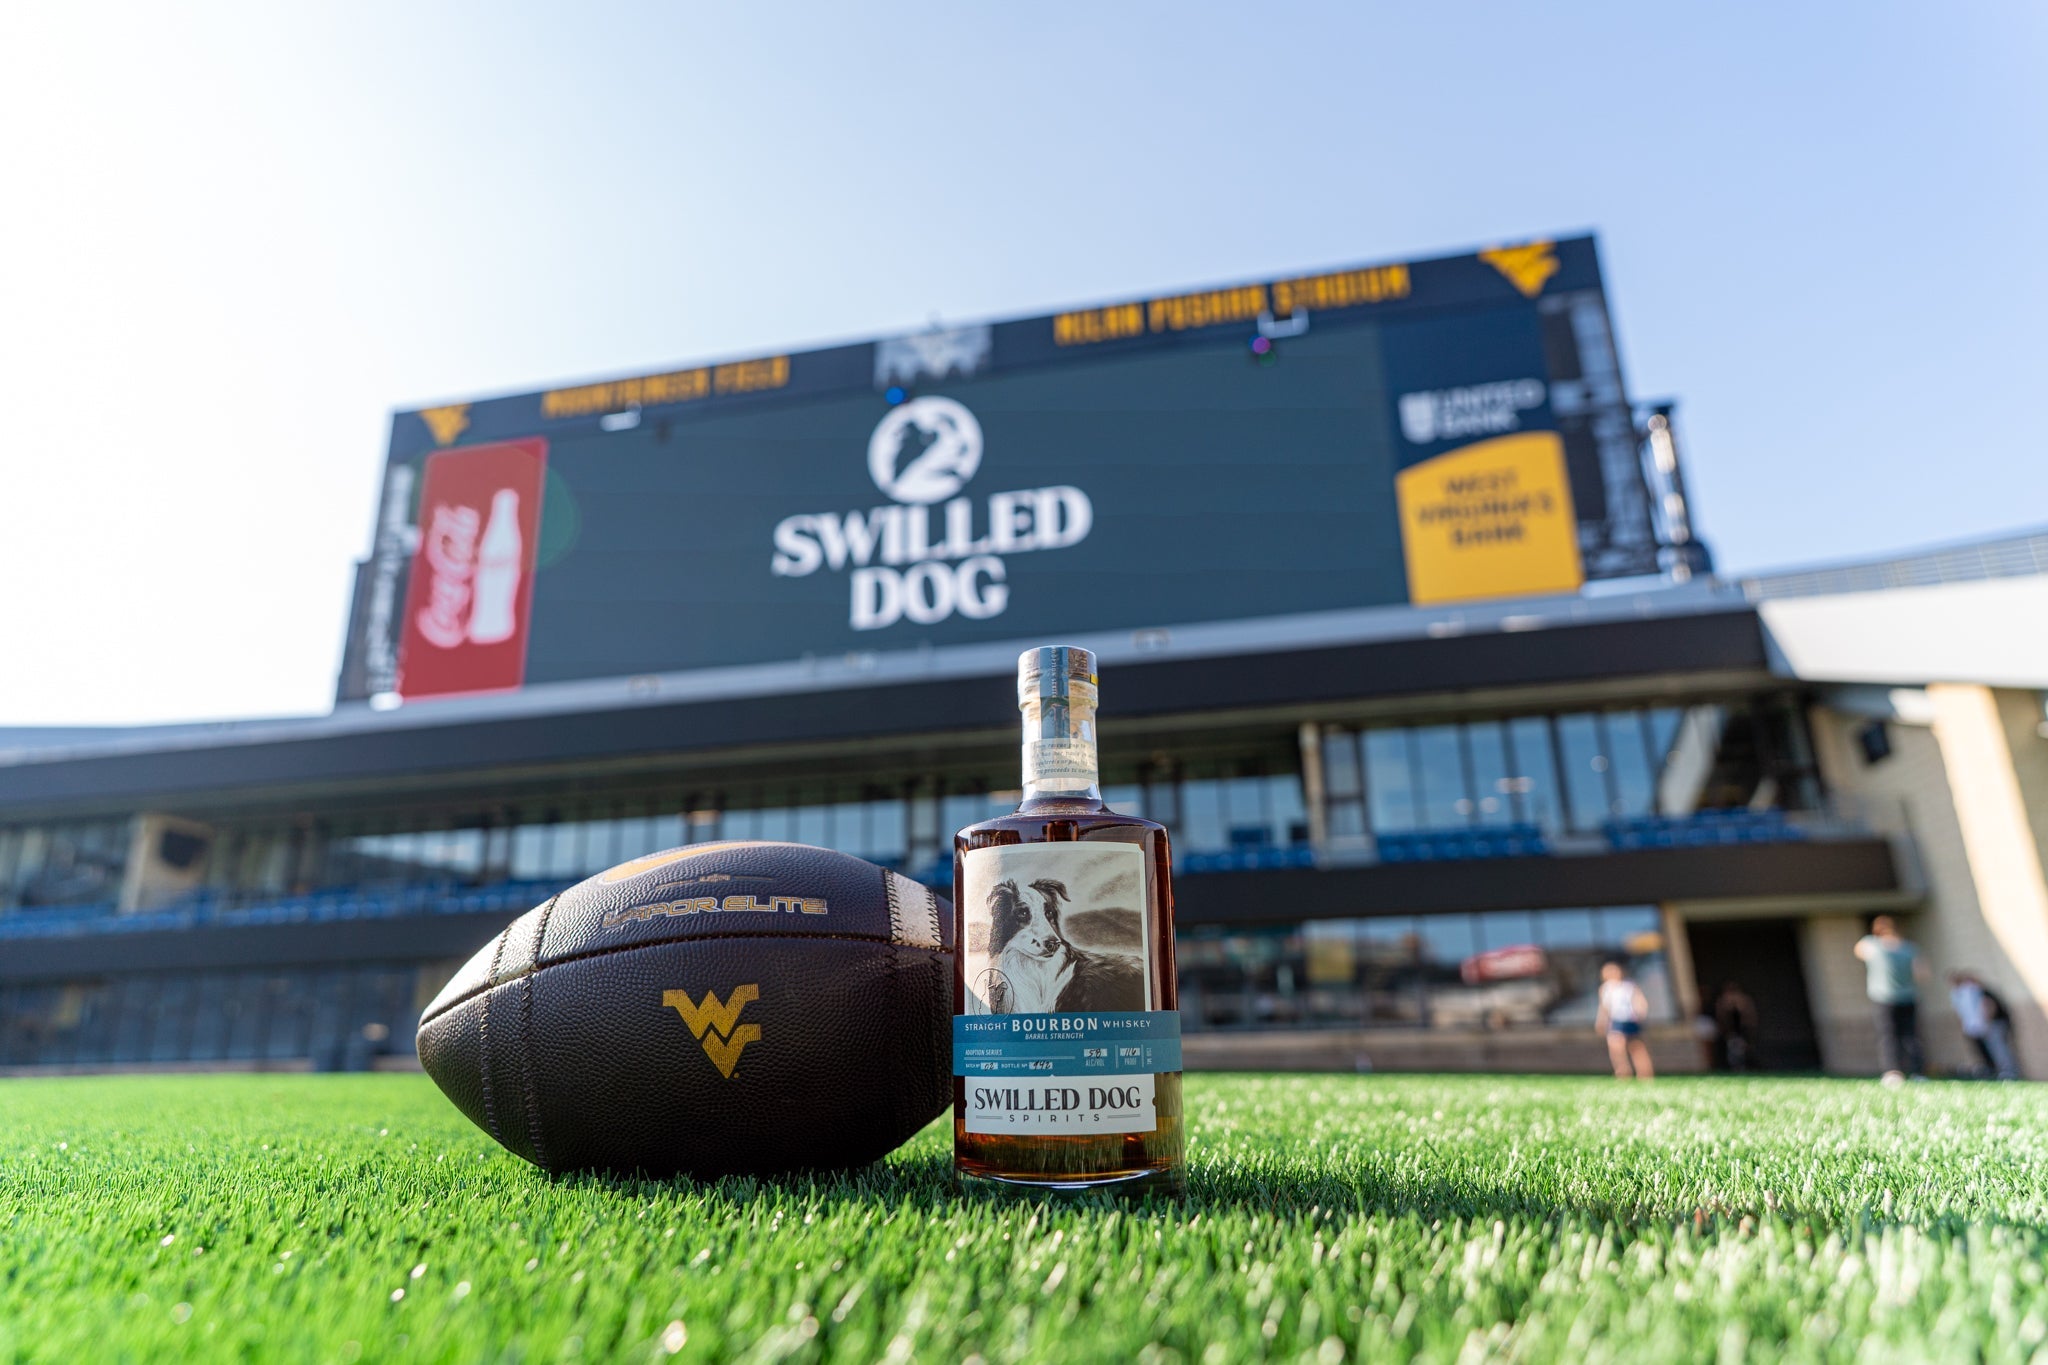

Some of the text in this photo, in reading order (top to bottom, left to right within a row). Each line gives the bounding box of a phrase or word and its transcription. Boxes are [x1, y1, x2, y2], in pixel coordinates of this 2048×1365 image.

[771, 484, 1094, 577] SWILLED
[850, 555, 1009, 632] DOG
[722, 895, 828, 915] ELITE
[964, 1017, 1151, 1032] STRAIGHT BOURBON WHISKEY
[1050, 1032, 1084, 1040] STRENGTH
[974, 1086, 1142, 1111] SWILLED DOG
[1009, 1113, 1100, 1122] SPIRITS
